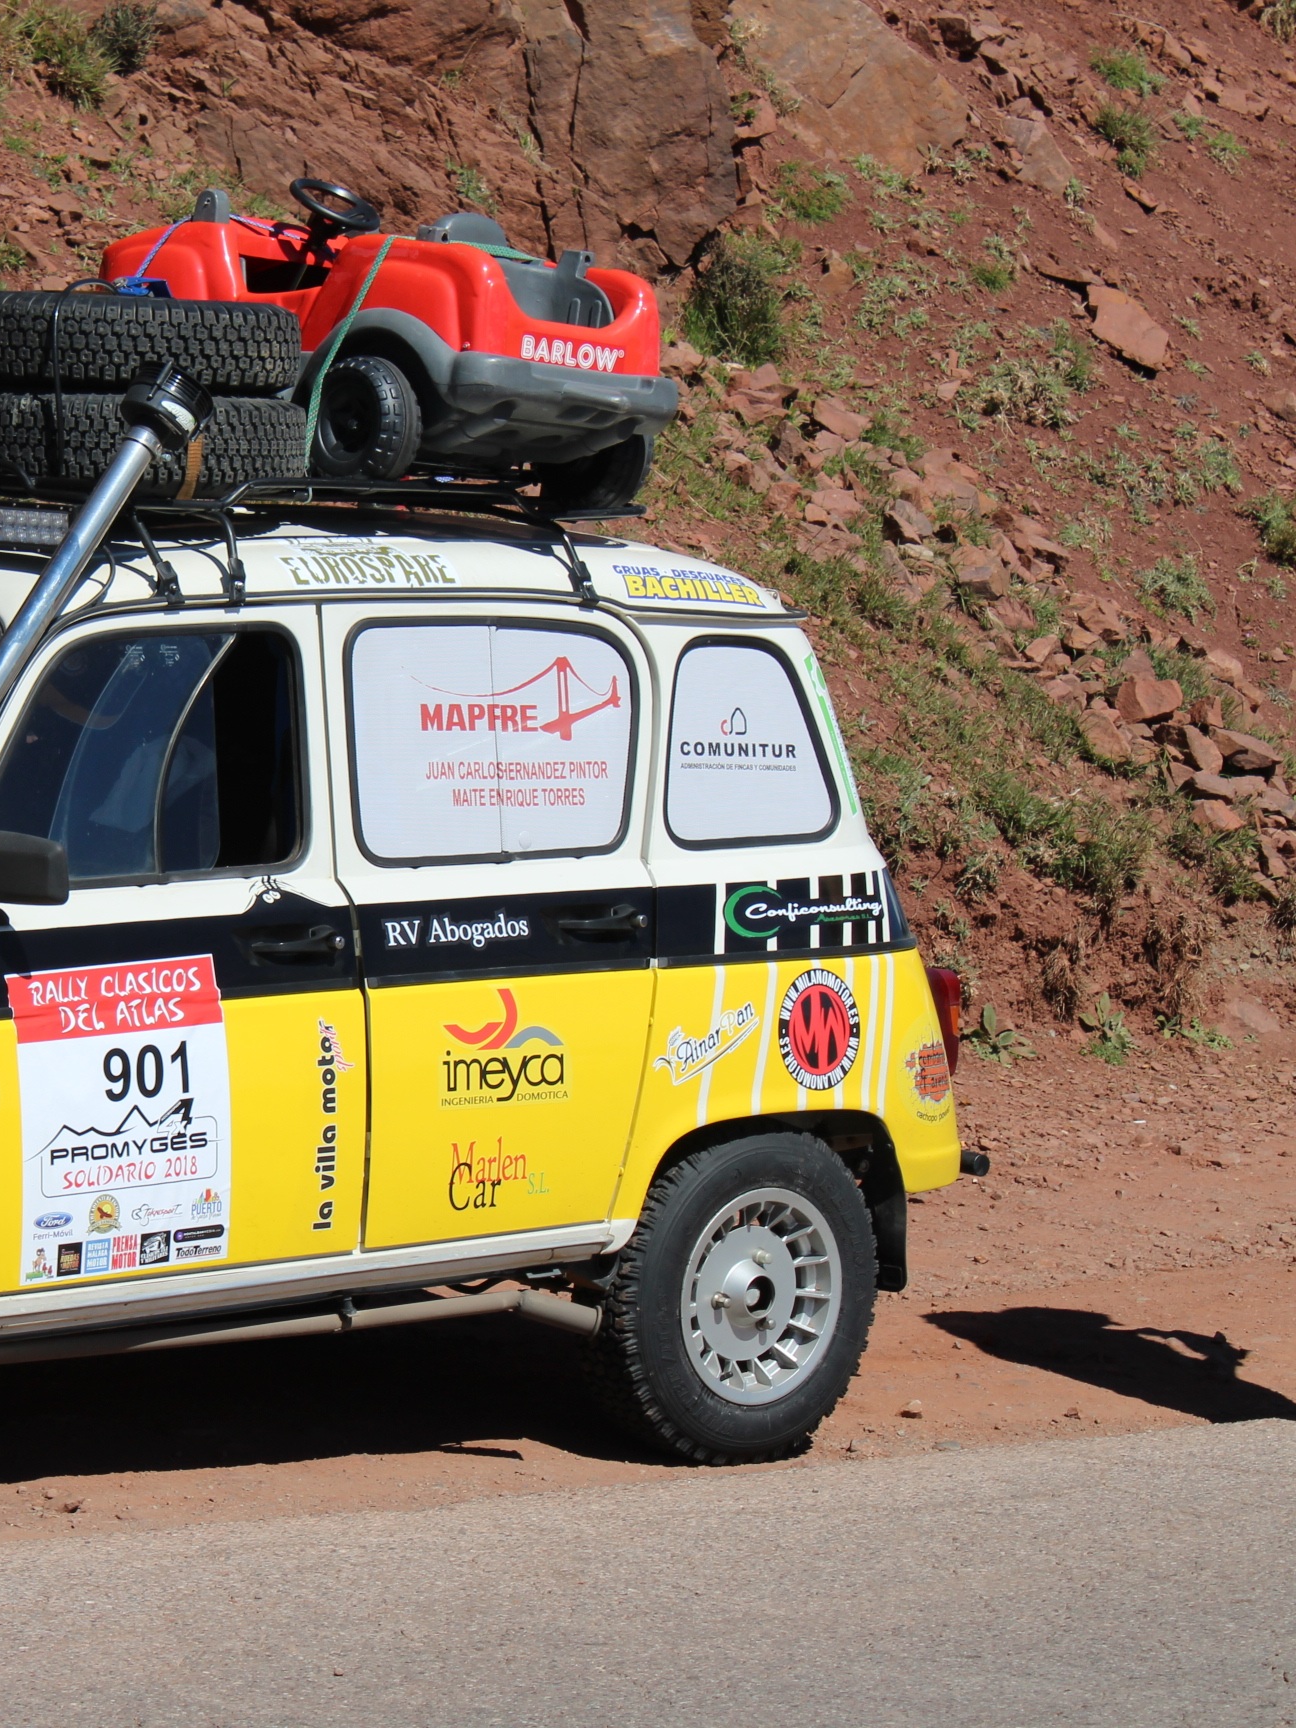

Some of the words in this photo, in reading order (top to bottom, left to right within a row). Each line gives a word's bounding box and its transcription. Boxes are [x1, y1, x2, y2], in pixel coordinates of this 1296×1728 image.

[521, 335, 618, 372] BARLOW
[280, 554, 456, 588] EUROSPARE
[612, 565, 660, 576] GRUAS
[671, 569, 745, 586] DESGUACES
[623, 575, 766, 608] BACHILLER
[420, 704, 538, 732] MAPFRE
[680, 741, 796, 758] COMUNITUR
[426, 762, 454, 780] JUAN
[458, 762, 504, 780] CARLOS
[569, 761, 608, 779] PINTOR
[453, 788, 486, 806] MAITE
[489, 788, 539, 807] ENRIQUE
[542, 788, 585, 806] TORRES
[745, 898, 882, 922] Conficonsulting
[385, 920, 420, 947] RV
[429, 914, 529, 947] Abogados
[27, 976, 89, 1007] RALLY
[100, 966, 201, 998] CLASICOS
[60, 1004, 105, 1033] DEL
[116, 997, 185, 1026] ATLAS
[103, 1040, 190, 1103] 901
[443, 1050, 565, 1102] imeyca
[441, 1095, 494, 1107] INGENIERIA
[516, 1090, 569, 1103] DOMOTICA
[50, 1132, 208, 1166] PROMYGES
[315, 1124, 337, 1191] villa
[449, 1136, 528, 1185] Marlen
[62, 1160, 156, 1190] SOLIDARIO
[165, 1156, 199, 1178] 2018
[448, 1162, 502, 1211] Car
[40, 1214, 66, 1227] Ford
[191, 1200, 222, 1217] PUERTO
[312, 1200, 334, 1231] la
[33, 1229, 73, 1241] Ferri-Móvil
[112, 1234, 138, 1253] PRENSA
[111, 1251, 137, 1270] MOTOR
[176, 1245, 222, 1258] TodoTerreno
